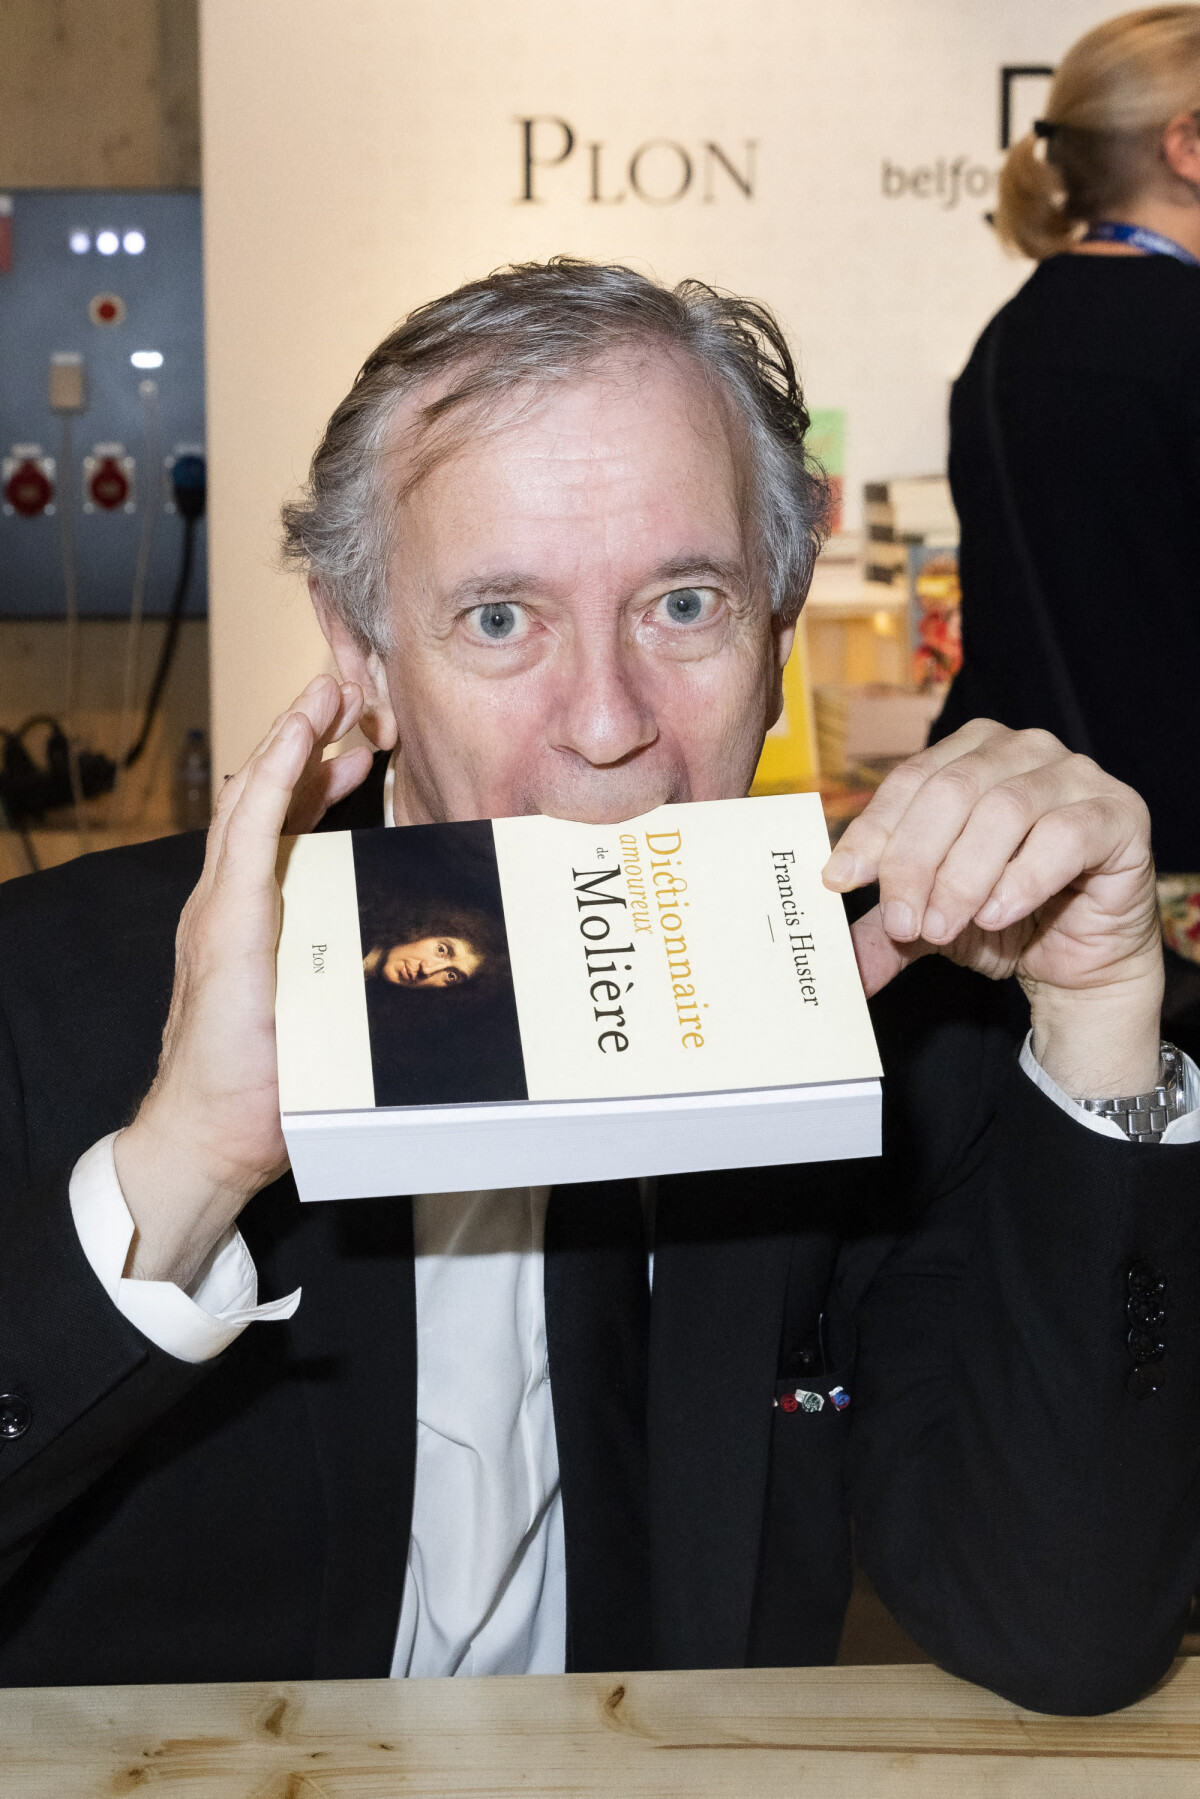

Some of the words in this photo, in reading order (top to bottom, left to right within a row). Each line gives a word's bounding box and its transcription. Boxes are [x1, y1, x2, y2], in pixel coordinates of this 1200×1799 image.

[510, 114, 760, 206] PLON
[880, 155, 999, 212] belfo
[596, 847, 608, 859] de
[619, 834, 653, 935] amoureux
[312, 944, 327, 974] PLON
[572, 864, 636, 1054] Molière
[644, 829, 709, 1049] Dictionnaire
[771, 850, 805, 926] Francis
[789, 933, 819, 1007] Huster
